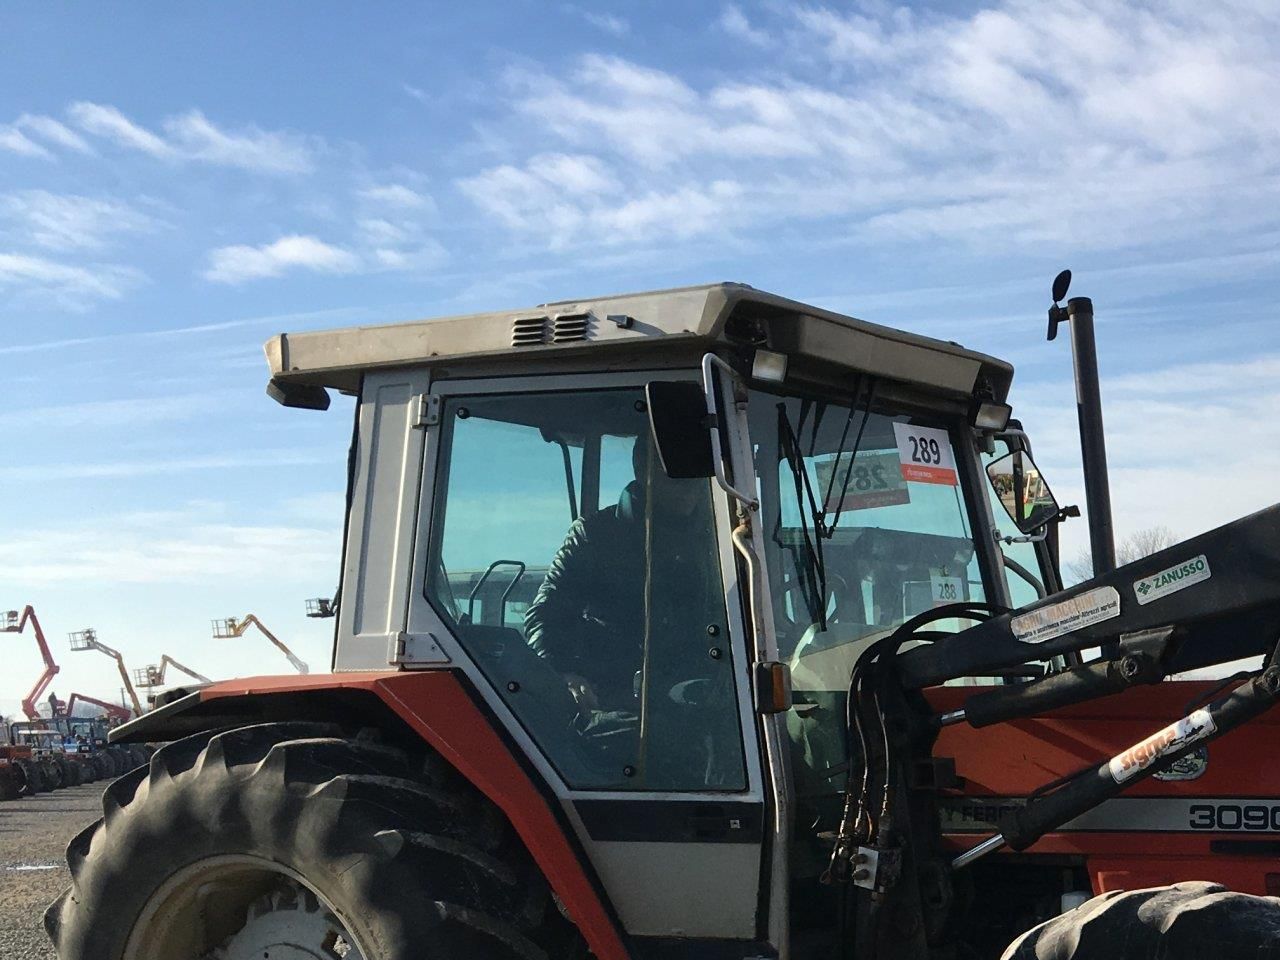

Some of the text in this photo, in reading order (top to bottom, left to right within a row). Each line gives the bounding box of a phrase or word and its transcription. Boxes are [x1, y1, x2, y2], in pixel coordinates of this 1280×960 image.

[908, 436, 941, 465] 289
[1153, 559, 1205, 589] ZANUSSO
[1120, 728, 1176, 771] sigma
